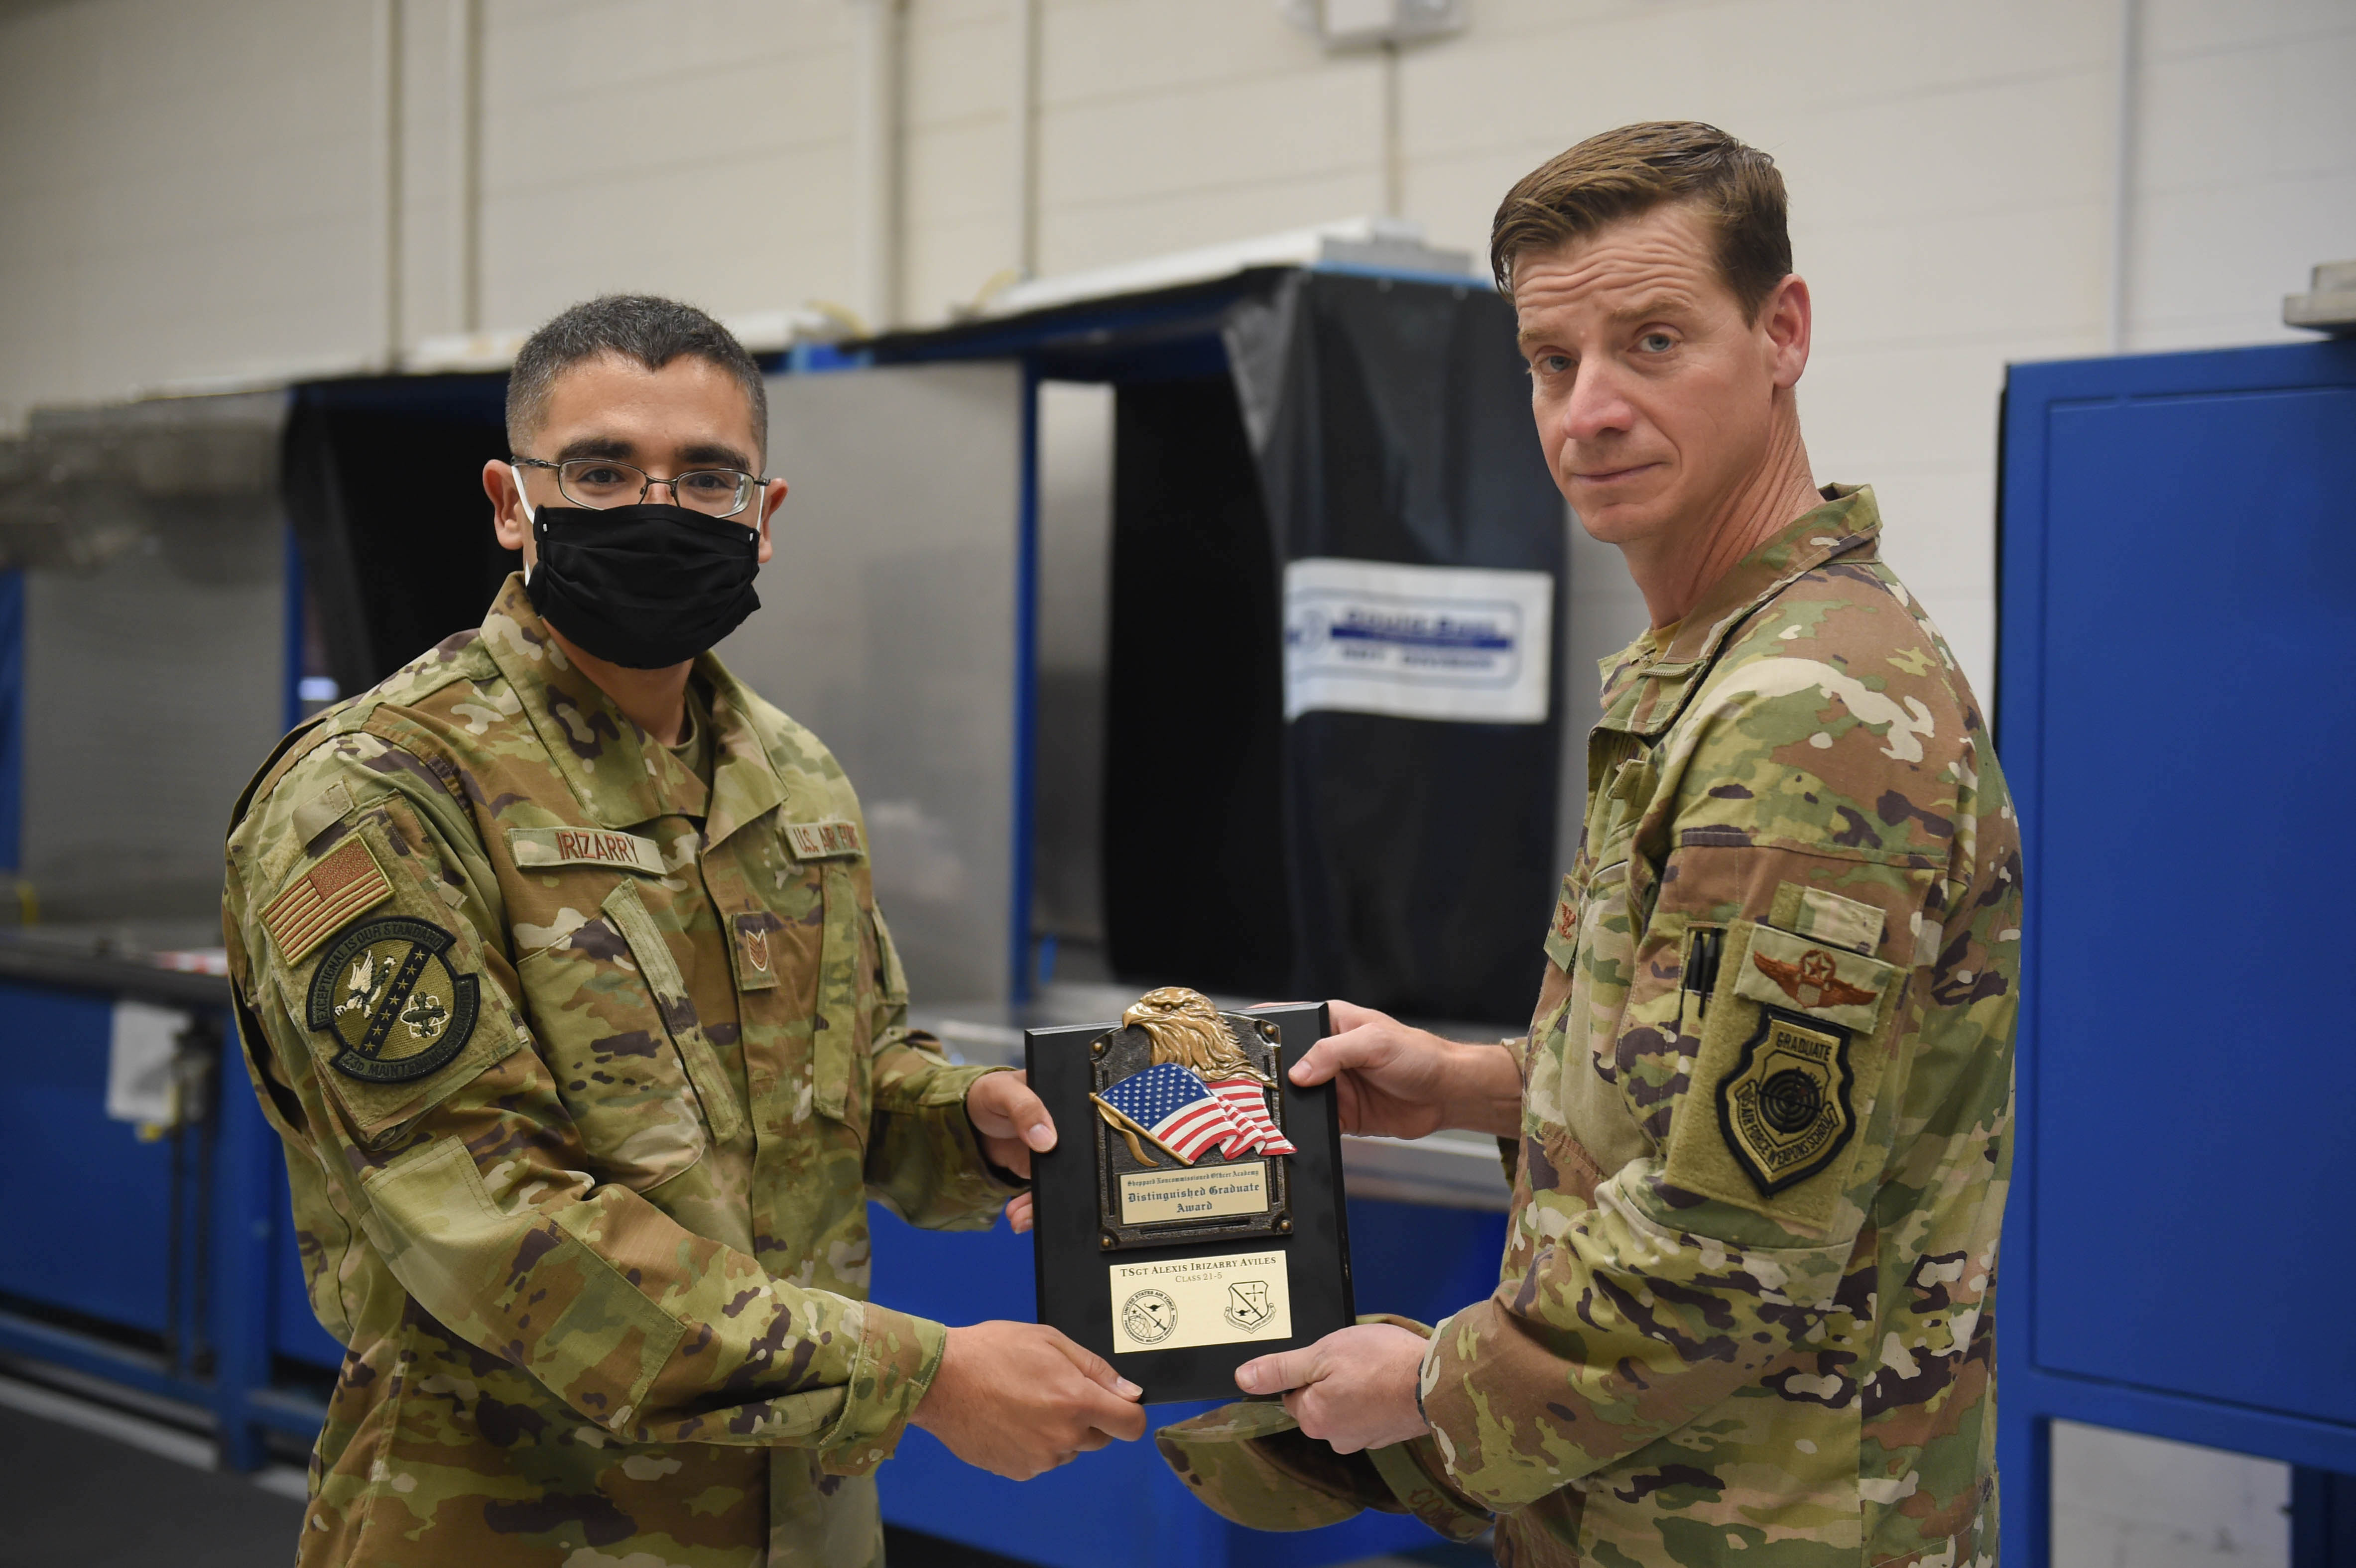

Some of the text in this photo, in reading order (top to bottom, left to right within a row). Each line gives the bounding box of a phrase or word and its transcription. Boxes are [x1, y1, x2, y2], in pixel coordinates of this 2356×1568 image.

[555, 832, 639, 864] IRIZARRY
[317, 948, 347, 1021] EXCEPTIONAL
[345, 938, 354, 952] IS
[357, 927, 381, 945] OUR
[1776, 1031, 1832, 1062] GRADUATE
[1128, 1183, 1259, 1203] Distinguished Graduate
[1177, 1201, 1212, 1213] Award
[1203, 1272, 1223, 1280] 21-5
